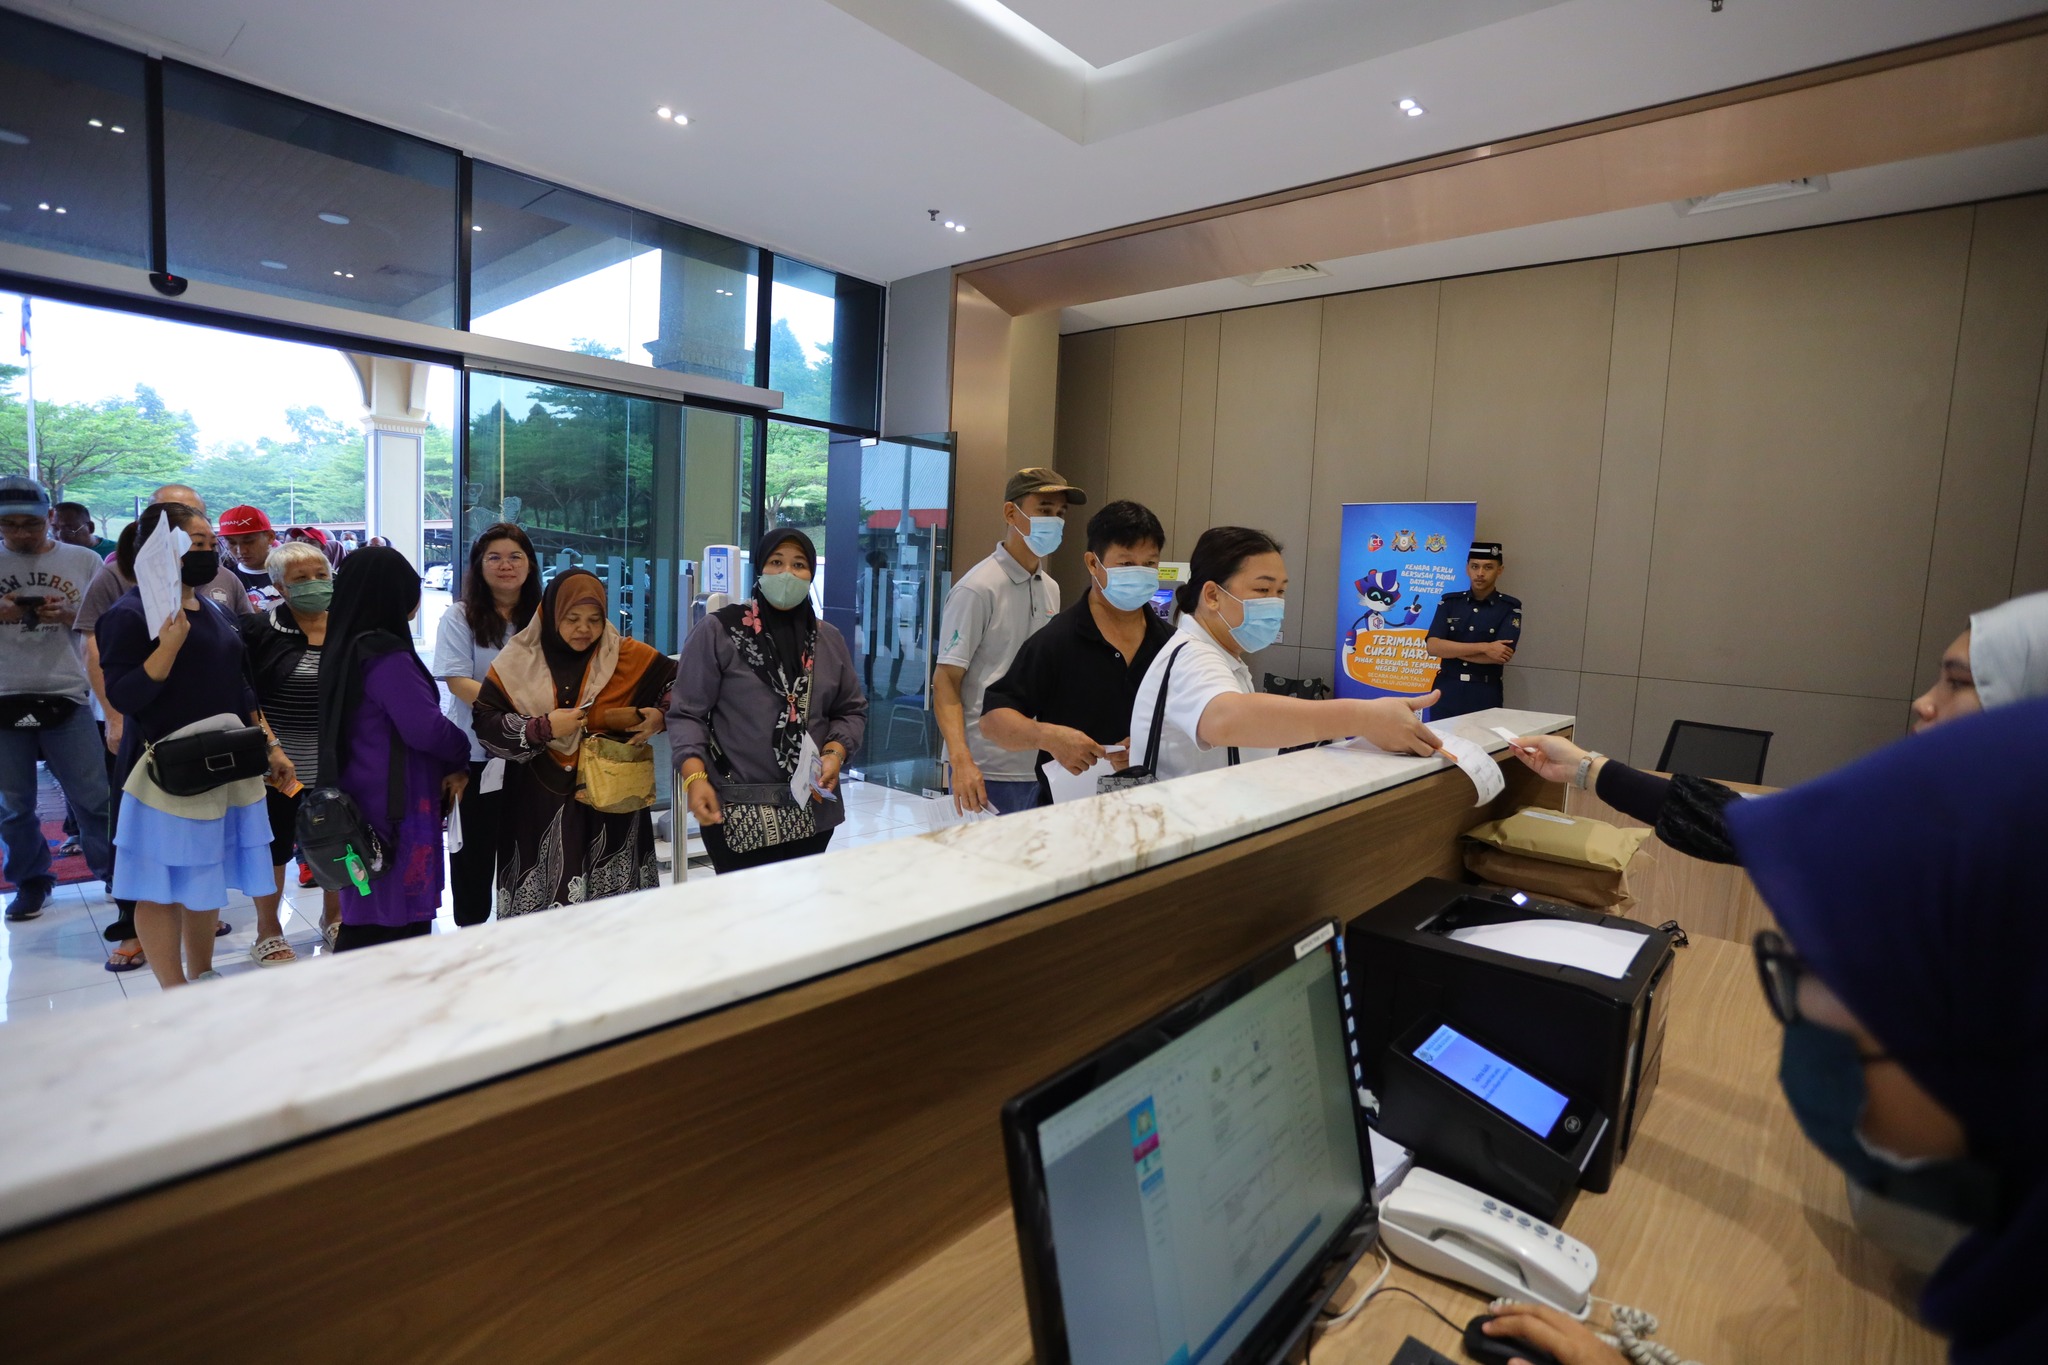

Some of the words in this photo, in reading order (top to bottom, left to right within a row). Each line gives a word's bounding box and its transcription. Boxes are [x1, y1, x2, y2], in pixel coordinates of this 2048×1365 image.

[26, 572, 80, 604] JERSEY
[1364, 645, 1396, 657] CUKAI
[1376, 658, 1408, 667] BERKUASA
[1412, 661, 1441, 670] TEMPATA
[762, 804, 777, 842] HRISTIAN
